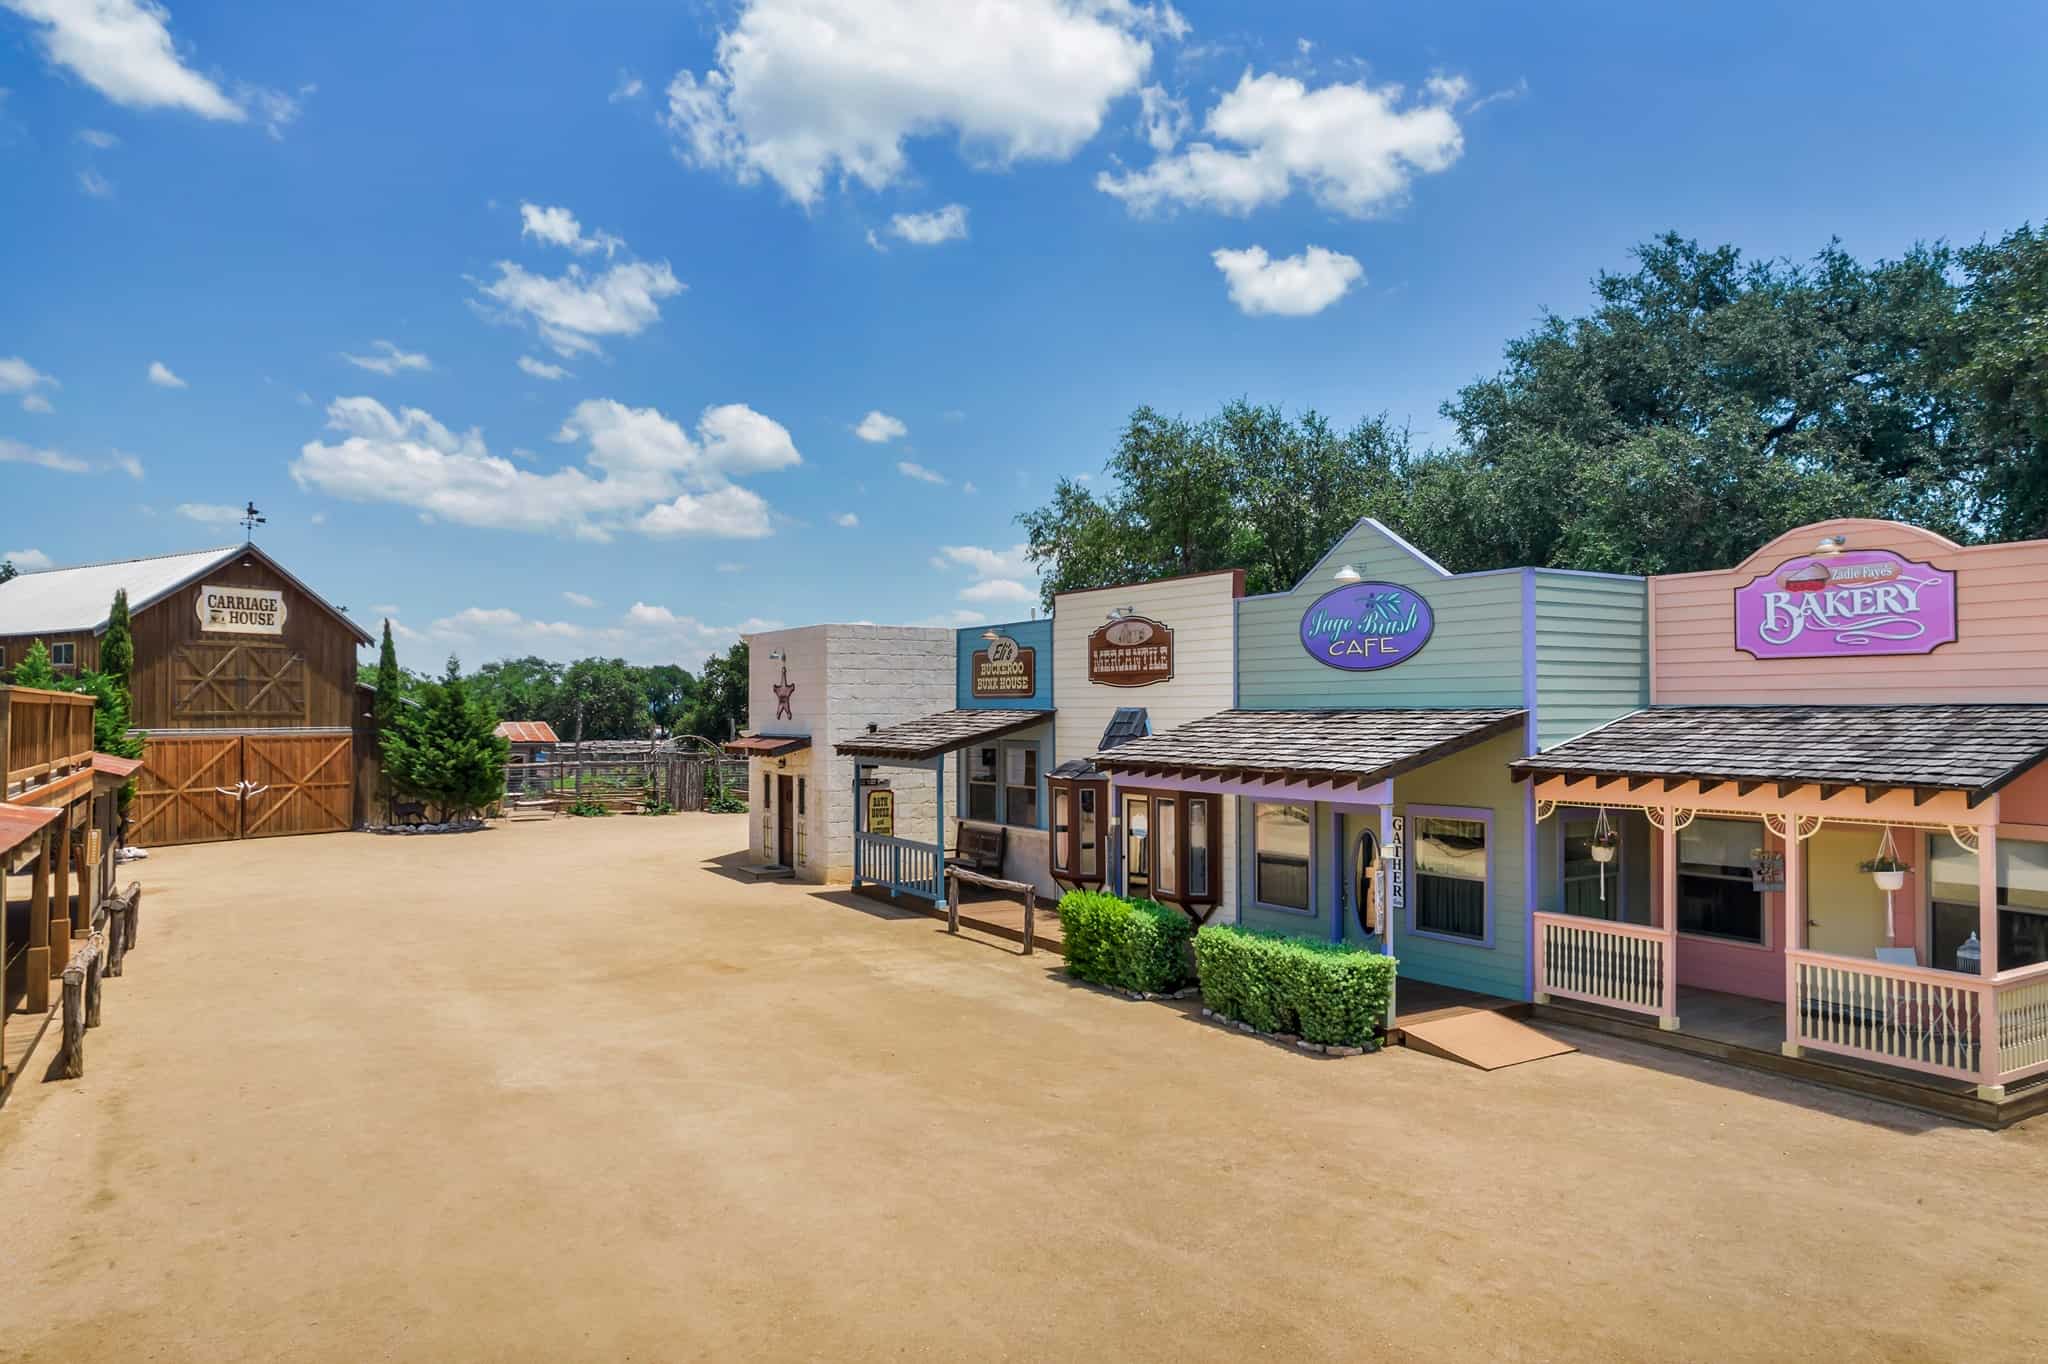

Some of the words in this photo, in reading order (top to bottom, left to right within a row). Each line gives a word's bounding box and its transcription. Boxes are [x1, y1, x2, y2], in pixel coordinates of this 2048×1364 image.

[207, 594, 278, 612] CARRIAGE
[1760, 584, 1923, 644] BAKERY
[229, 611, 275, 626] HOUSE
[1357, 602, 1418, 634] Brush
[1329, 636, 1400, 657] CAFE
[1094, 647, 1168, 672] MERCANTILE
[1000, 676, 1029, 690] HOUSE
[1392, 819, 1402, 897] GATHER
